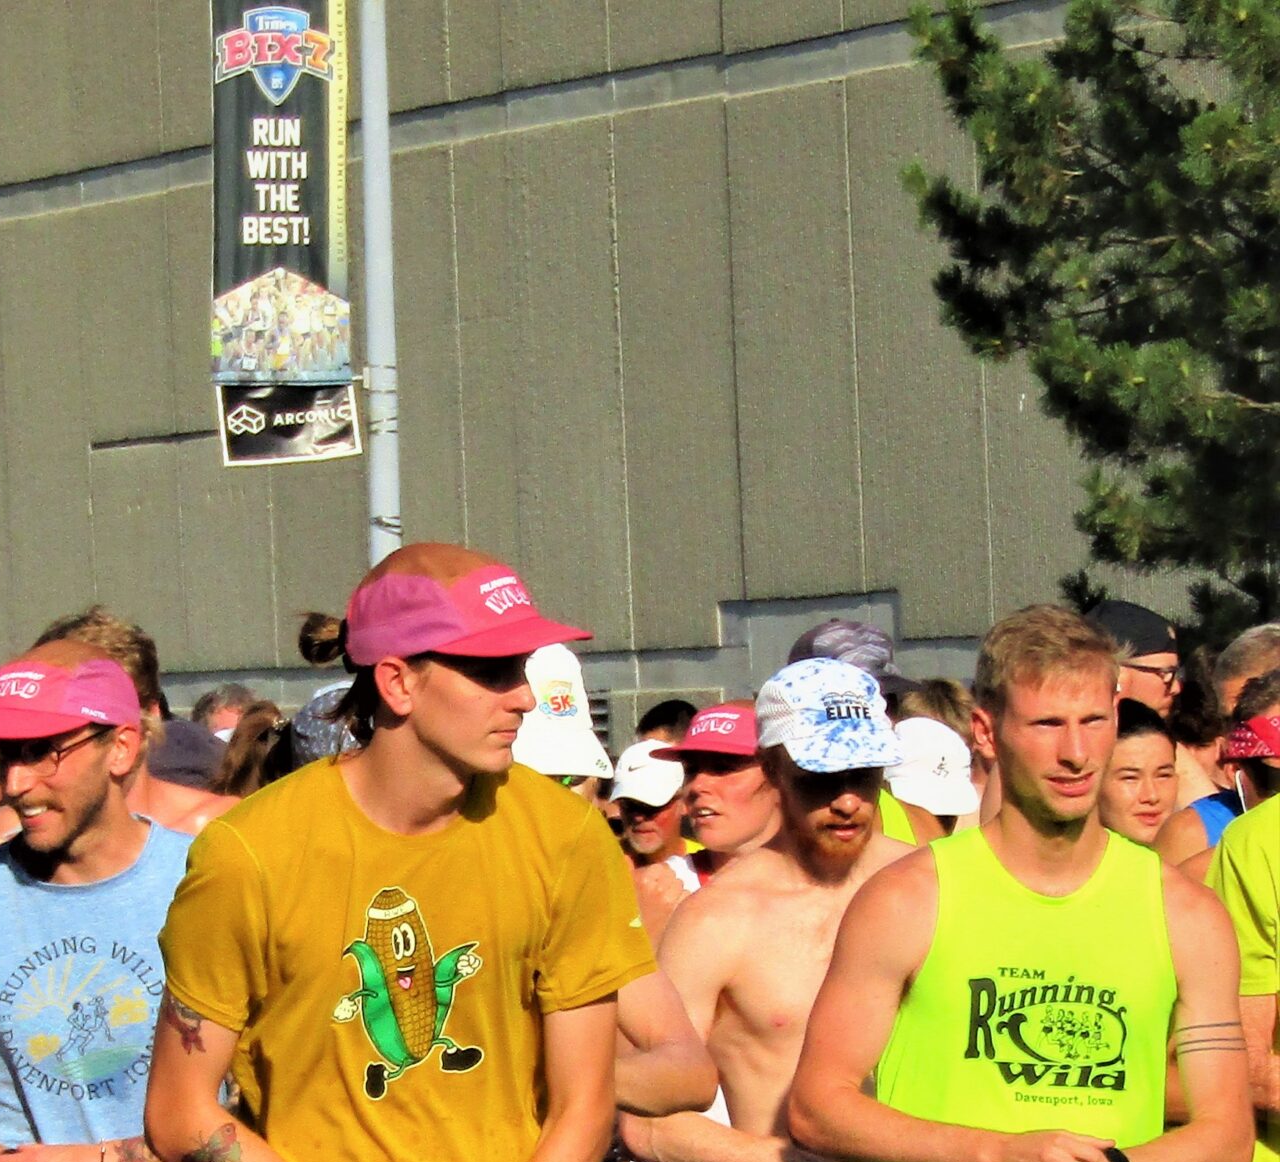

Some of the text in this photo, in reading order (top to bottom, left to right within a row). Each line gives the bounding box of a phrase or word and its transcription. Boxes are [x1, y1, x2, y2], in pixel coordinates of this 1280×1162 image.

[253, 118, 301, 146] RUN
[246, 151, 308, 179] WITH
[255, 184, 300, 212] THE
[243, 216, 310, 245] BEST!
[826, 705, 872, 721] ELITE
[110, 941, 165, 997] WILD
[997, 966, 1046, 980] TEAM
[963, 975, 1128, 1060] Running
[0, 1028, 117, 1101] DAVENPORT
[993, 1061, 1127, 1091] Wild
[1014, 1092, 1114, 1107] Davenport, Iowa
